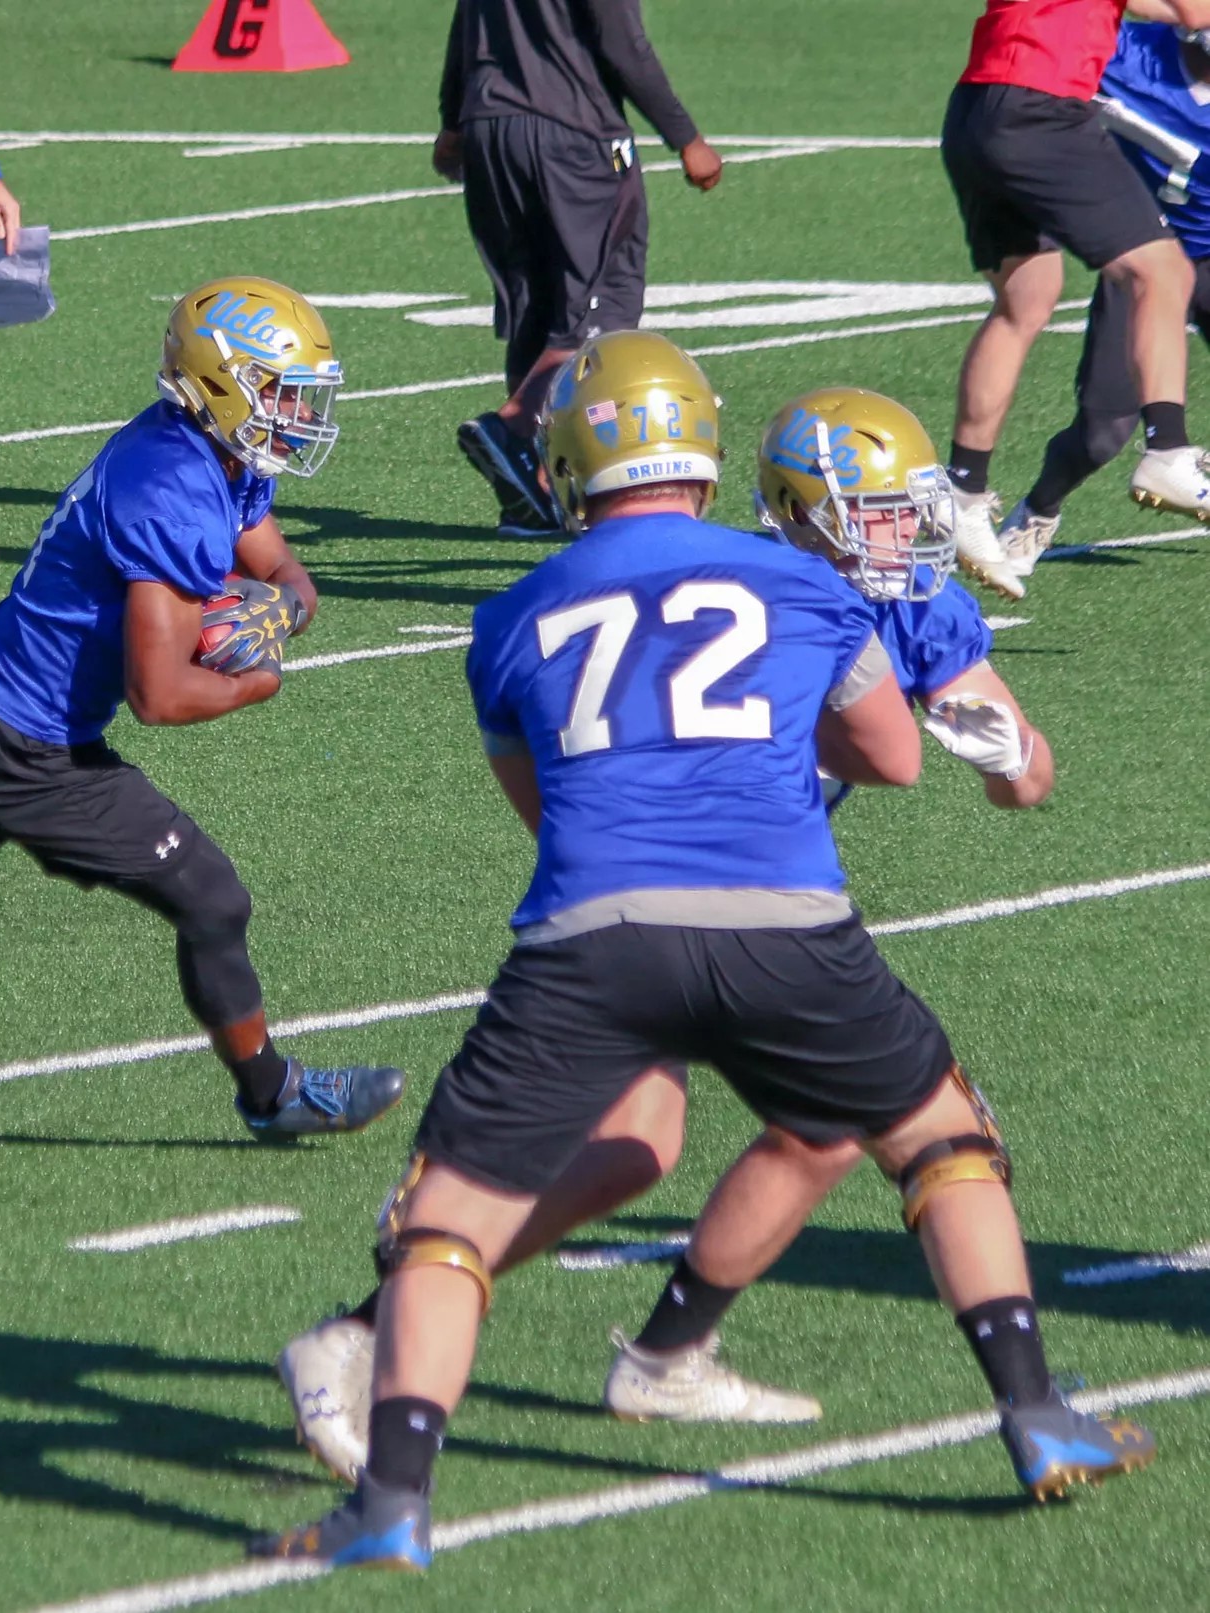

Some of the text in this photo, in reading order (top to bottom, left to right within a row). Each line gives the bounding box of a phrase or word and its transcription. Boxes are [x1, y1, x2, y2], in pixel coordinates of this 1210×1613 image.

[213, 0, 270, 59] G
[626, 460, 693, 480] BRUINS
[537, 580, 773, 757] 72
